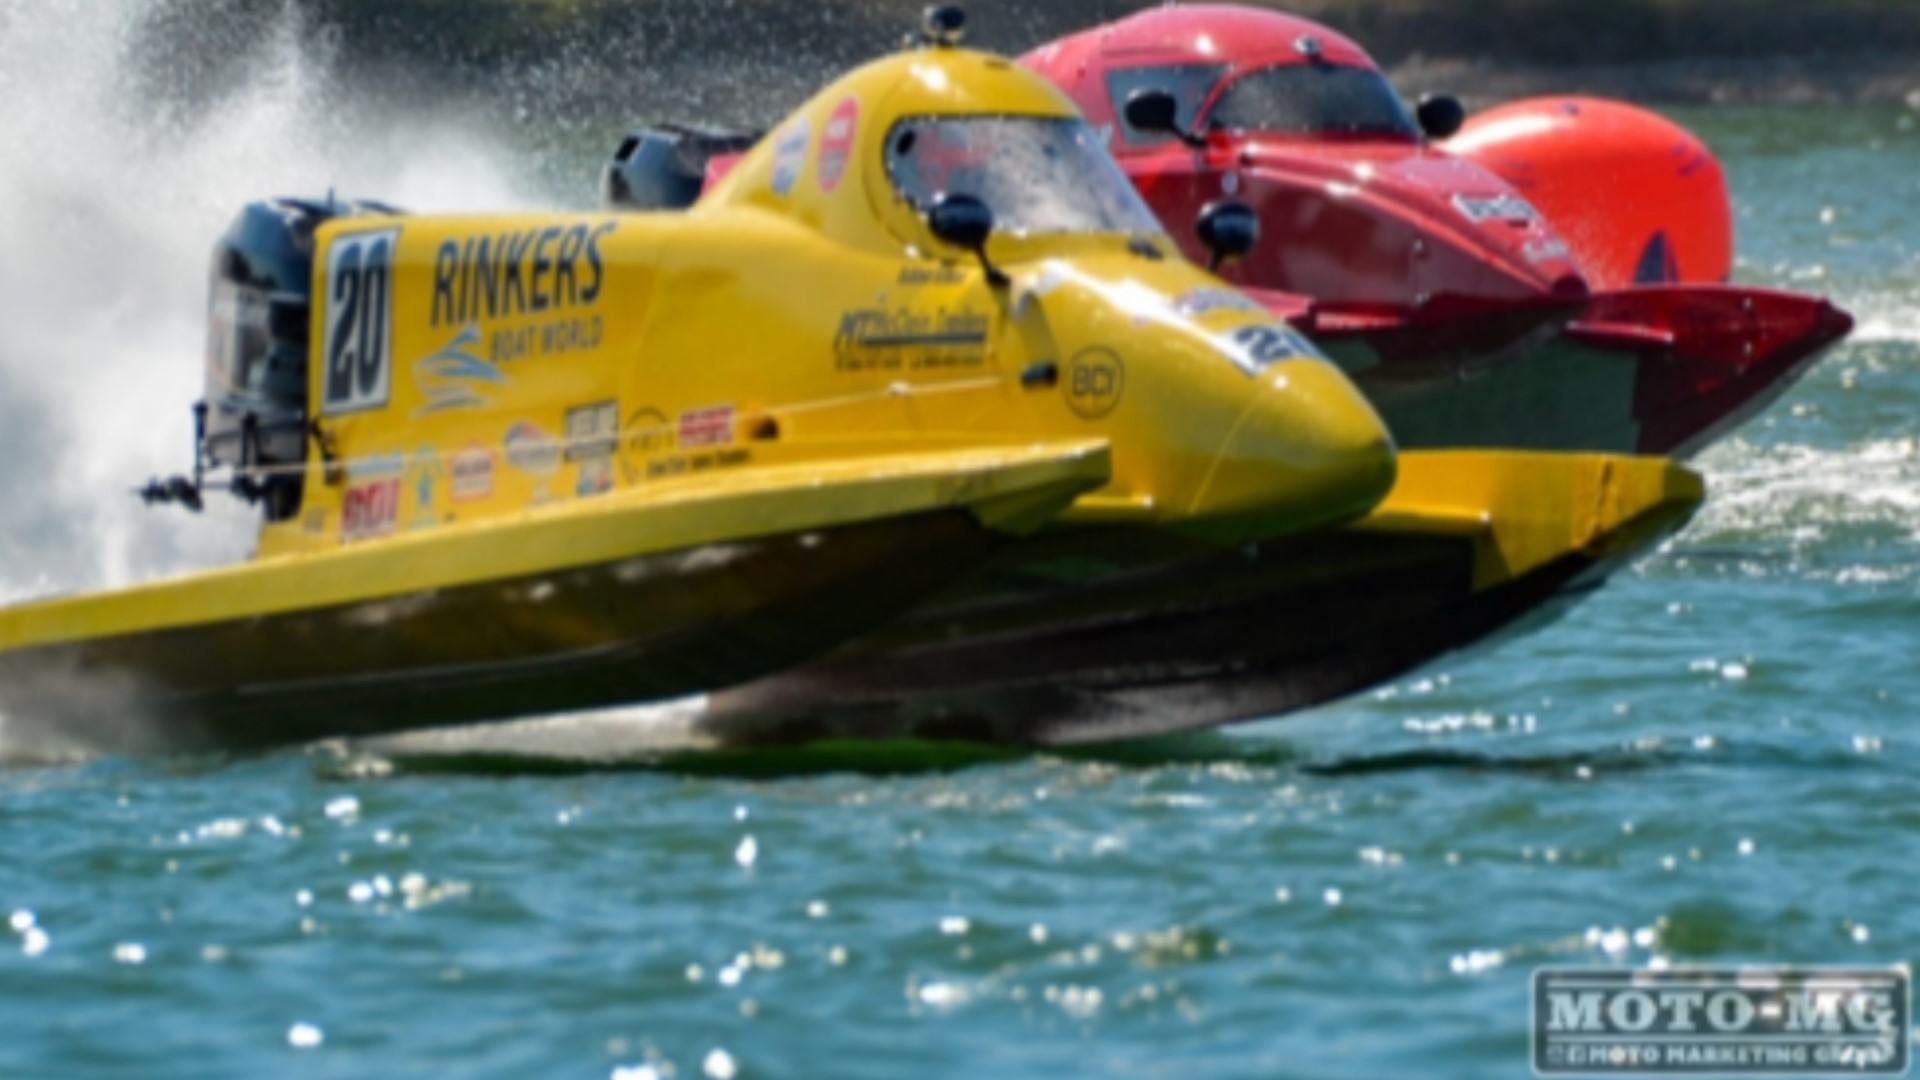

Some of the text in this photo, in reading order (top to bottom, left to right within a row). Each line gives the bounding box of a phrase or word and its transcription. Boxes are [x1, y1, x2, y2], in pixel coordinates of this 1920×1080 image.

[326, 237, 390, 402] 20
[430, 221, 618, 328] RINKERS
[490, 315, 604, 363] BOAT WORLD
